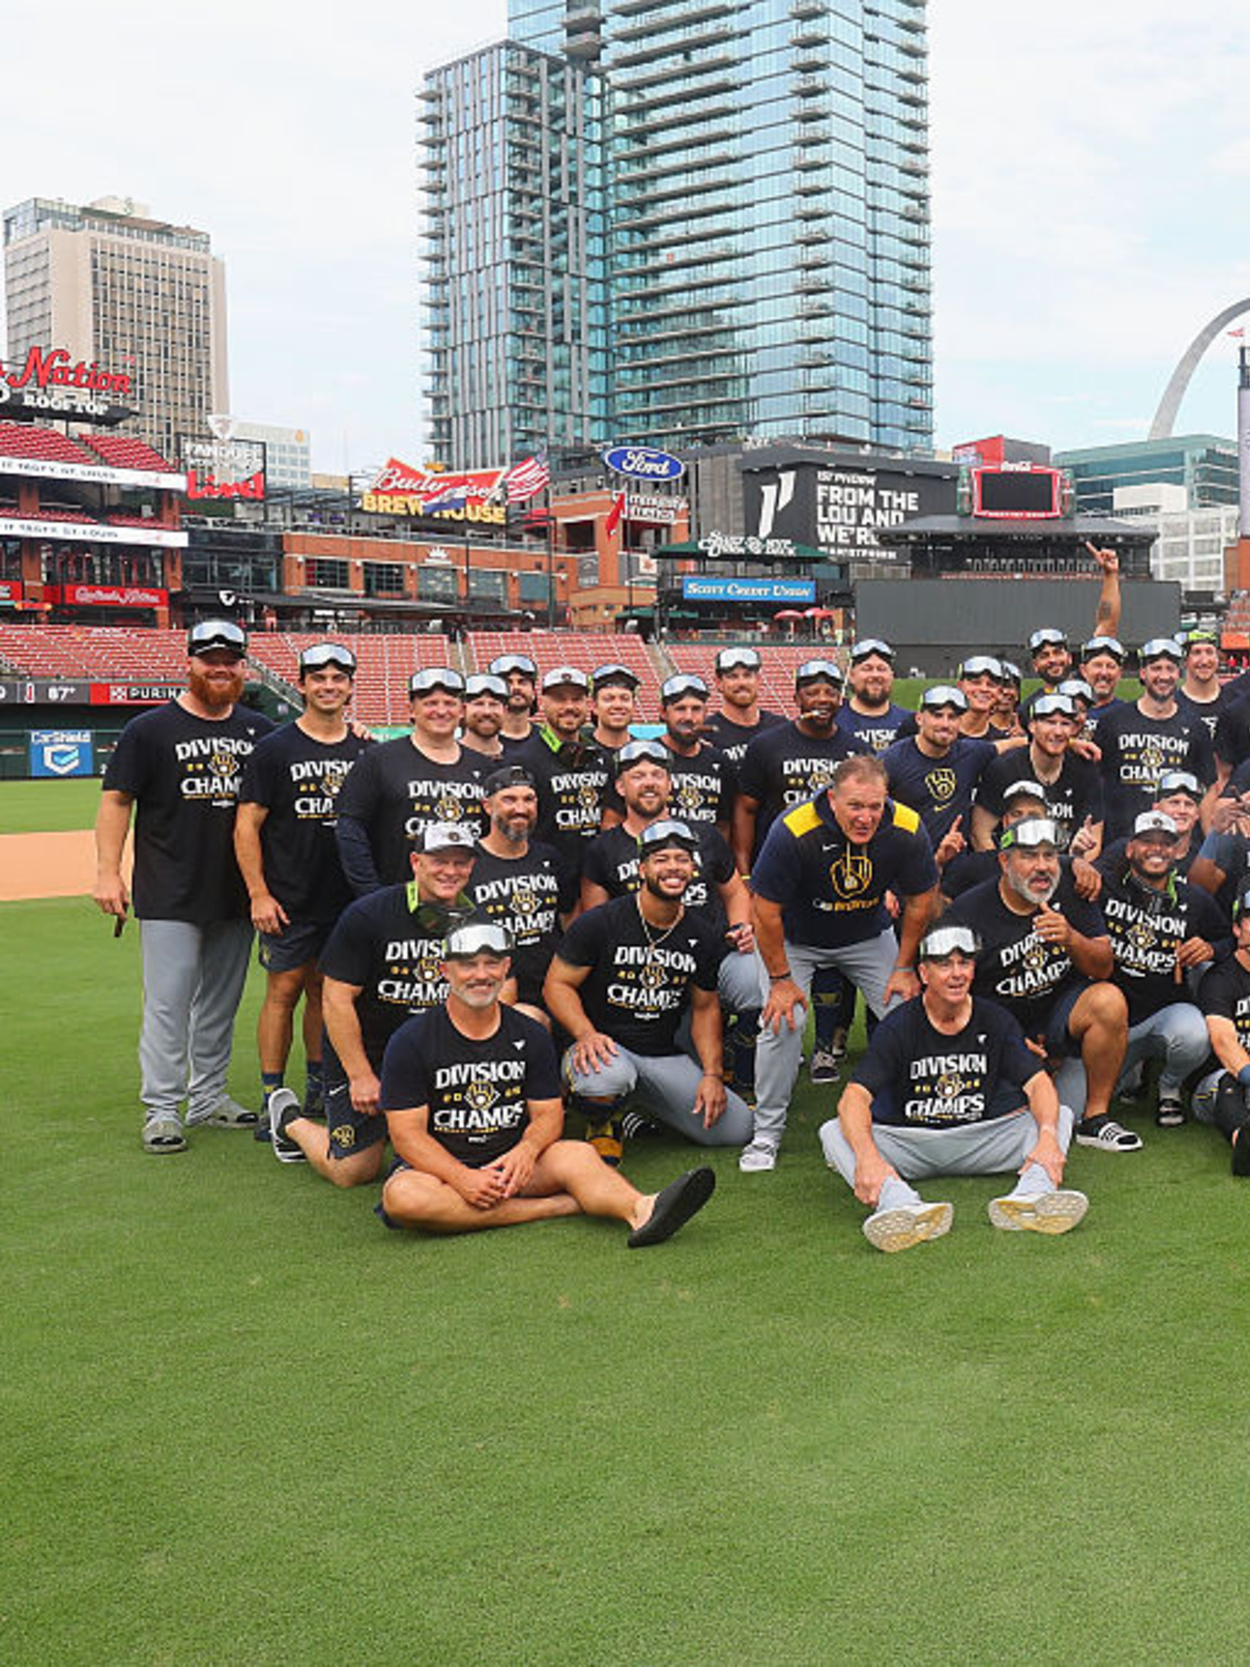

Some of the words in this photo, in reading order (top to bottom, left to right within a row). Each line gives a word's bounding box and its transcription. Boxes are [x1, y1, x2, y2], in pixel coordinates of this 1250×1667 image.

[6, 346, 132, 394] Nation
[22, 393, 109, 415] ROOFTOP
[622, 449, 671, 475] Ford
[362, 493, 423, 516] BREW
[817, 485, 875, 507] FROM
[878, 490, 919, 511] THE
[817, 505, 858, 525] LOU
[861, 508, 905, 527] AND
[687, 582, 726, 596] SCOTT
[727, 583, 771, 597] CREDIT
[773, 584, 811, 598] UNION
[175, 738, 256, 760] DIVISIO
[1119, 734, 1190, 755] DIVISION
[290, 760, 355, 782] DIVIS
[1120, 765, 1176, 781] CHAM
[180, 776, 242, 798] CHAM
[671, 772, 722, 794] VISION
[294, 797, 335, 814] CHA
[555, 808, 601, 826] CHAM
[475, 873, 559, 904] DIVISION
[1104, 898, 1187, 938] DIVISION
[613, 946, 697, 973] DIVISION
[996, 957, 1073, 994] CHAMPS
[434, 1060, 526, 1089] DIVISION
[910, 1053, 987, 1080] DIVISION
[433, 1101, 524, 1130] CHAMPS
[905, 1092, 985, 1118] CHAMPS
